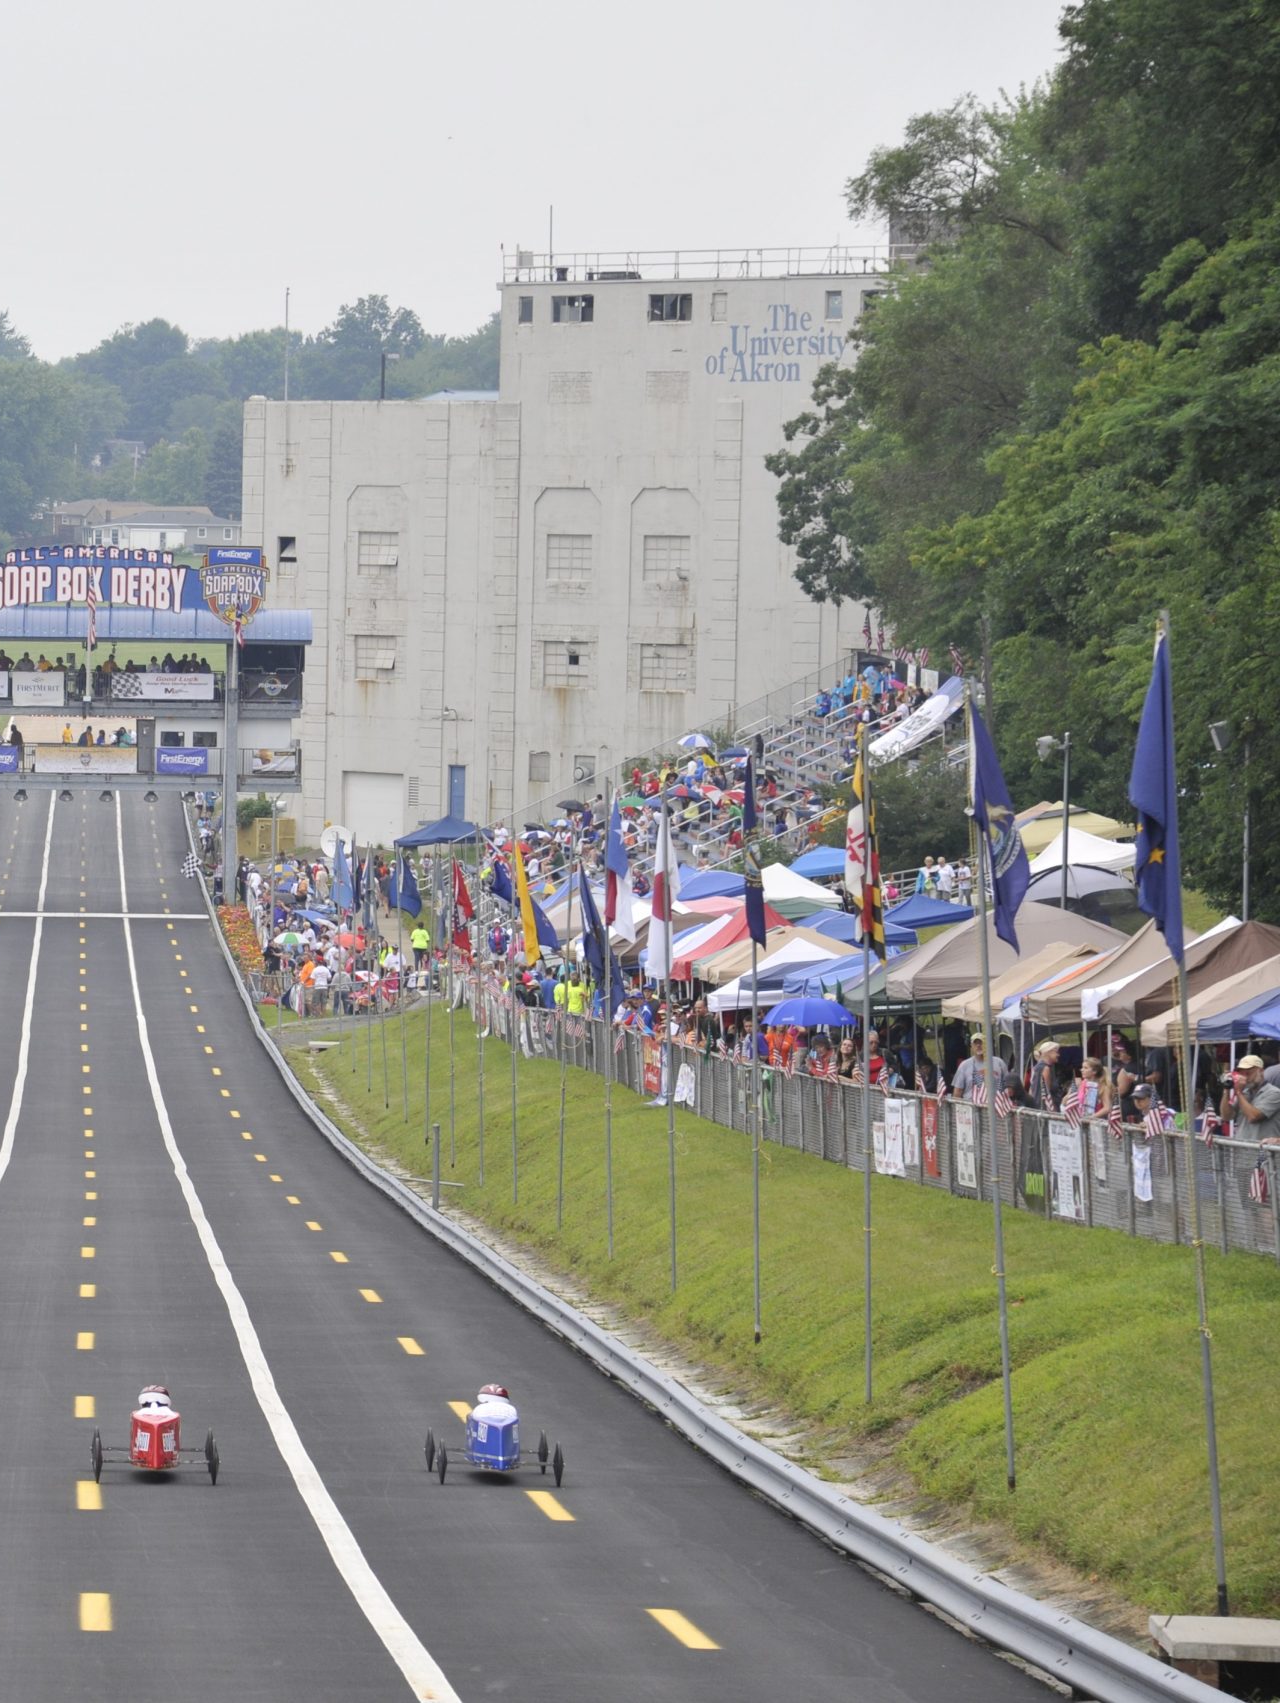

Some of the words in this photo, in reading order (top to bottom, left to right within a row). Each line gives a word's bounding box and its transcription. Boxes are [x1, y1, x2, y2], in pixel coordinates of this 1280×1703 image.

[768, 304, 812, 332] The
[730, 325, 847, 361] University
[705, 346, 729, 375] of
[729, 350, 801, 383] Akron
[6, 547, 173, 565] ALL-AMERICAN
[217, 550, 253, 560] FirstEnergy
[56, 565, 104, 602] BOX
[111, 567, 187, 614] DERBY
[206, 575, 236, 596] SOAP
[238, 575, 262, 596] BOX
[160, 753, 206, 766] FirstEnergy
